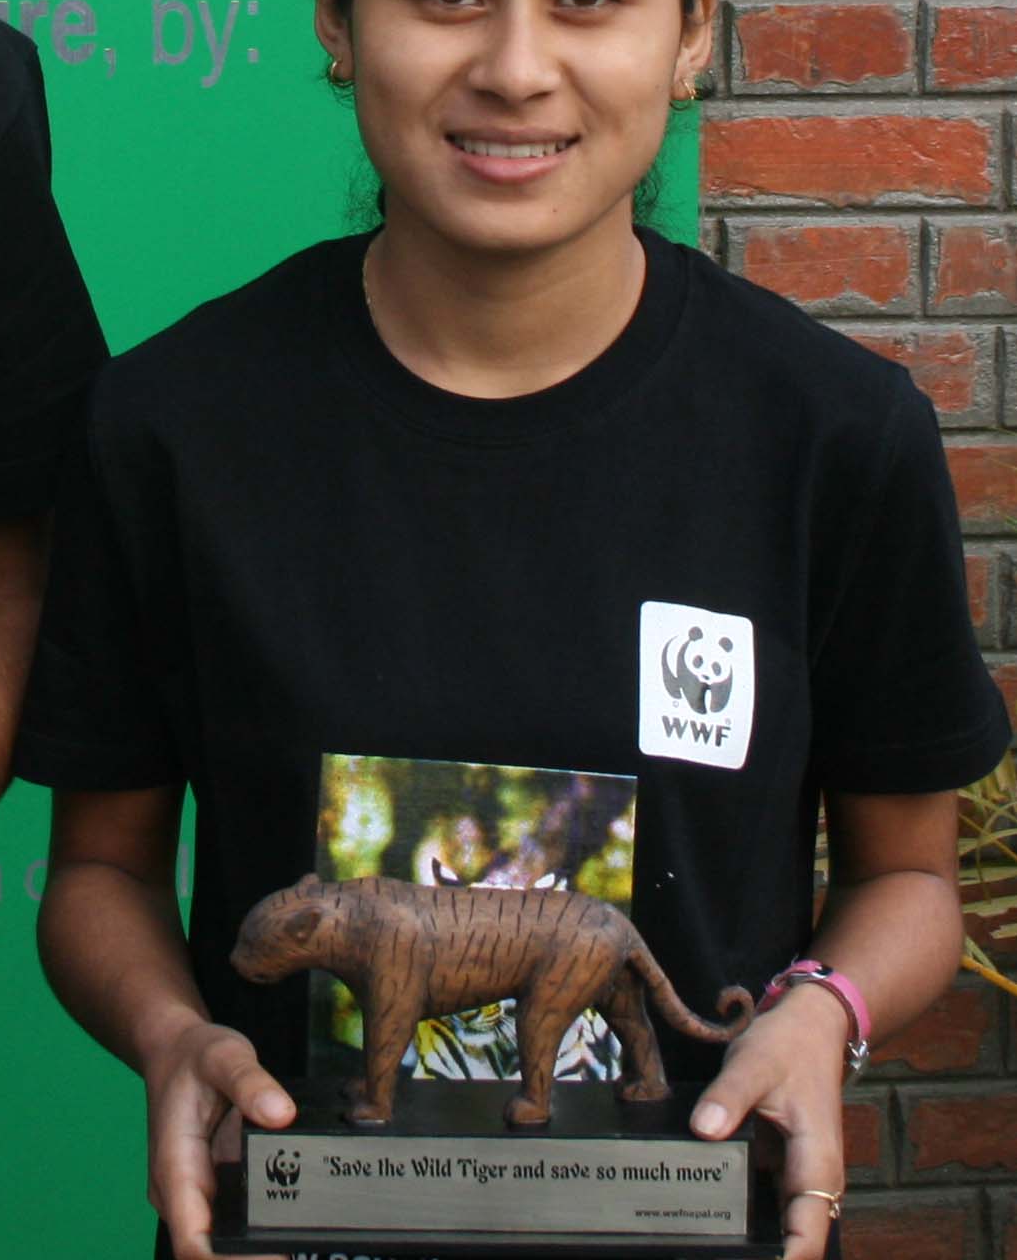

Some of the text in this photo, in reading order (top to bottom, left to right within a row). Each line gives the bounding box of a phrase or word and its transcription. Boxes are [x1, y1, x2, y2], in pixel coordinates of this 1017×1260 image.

[661, 715, 732, 748] WWF
[378, 1157, 406, 1178] the
[411, 1157, 453, 1178] Wild
[457, 1158, 508, 1184] Tiger
[512, 1160, 545, 1180] and
[551, 1162, 591, 1180] save
[596, 1165, 617, 1181] so
[622, 1161, 672, 1182] much
[266, 1189, 301, 1201] WWF
[635, 1208, 732, 1221] www.wwfnepal.org
